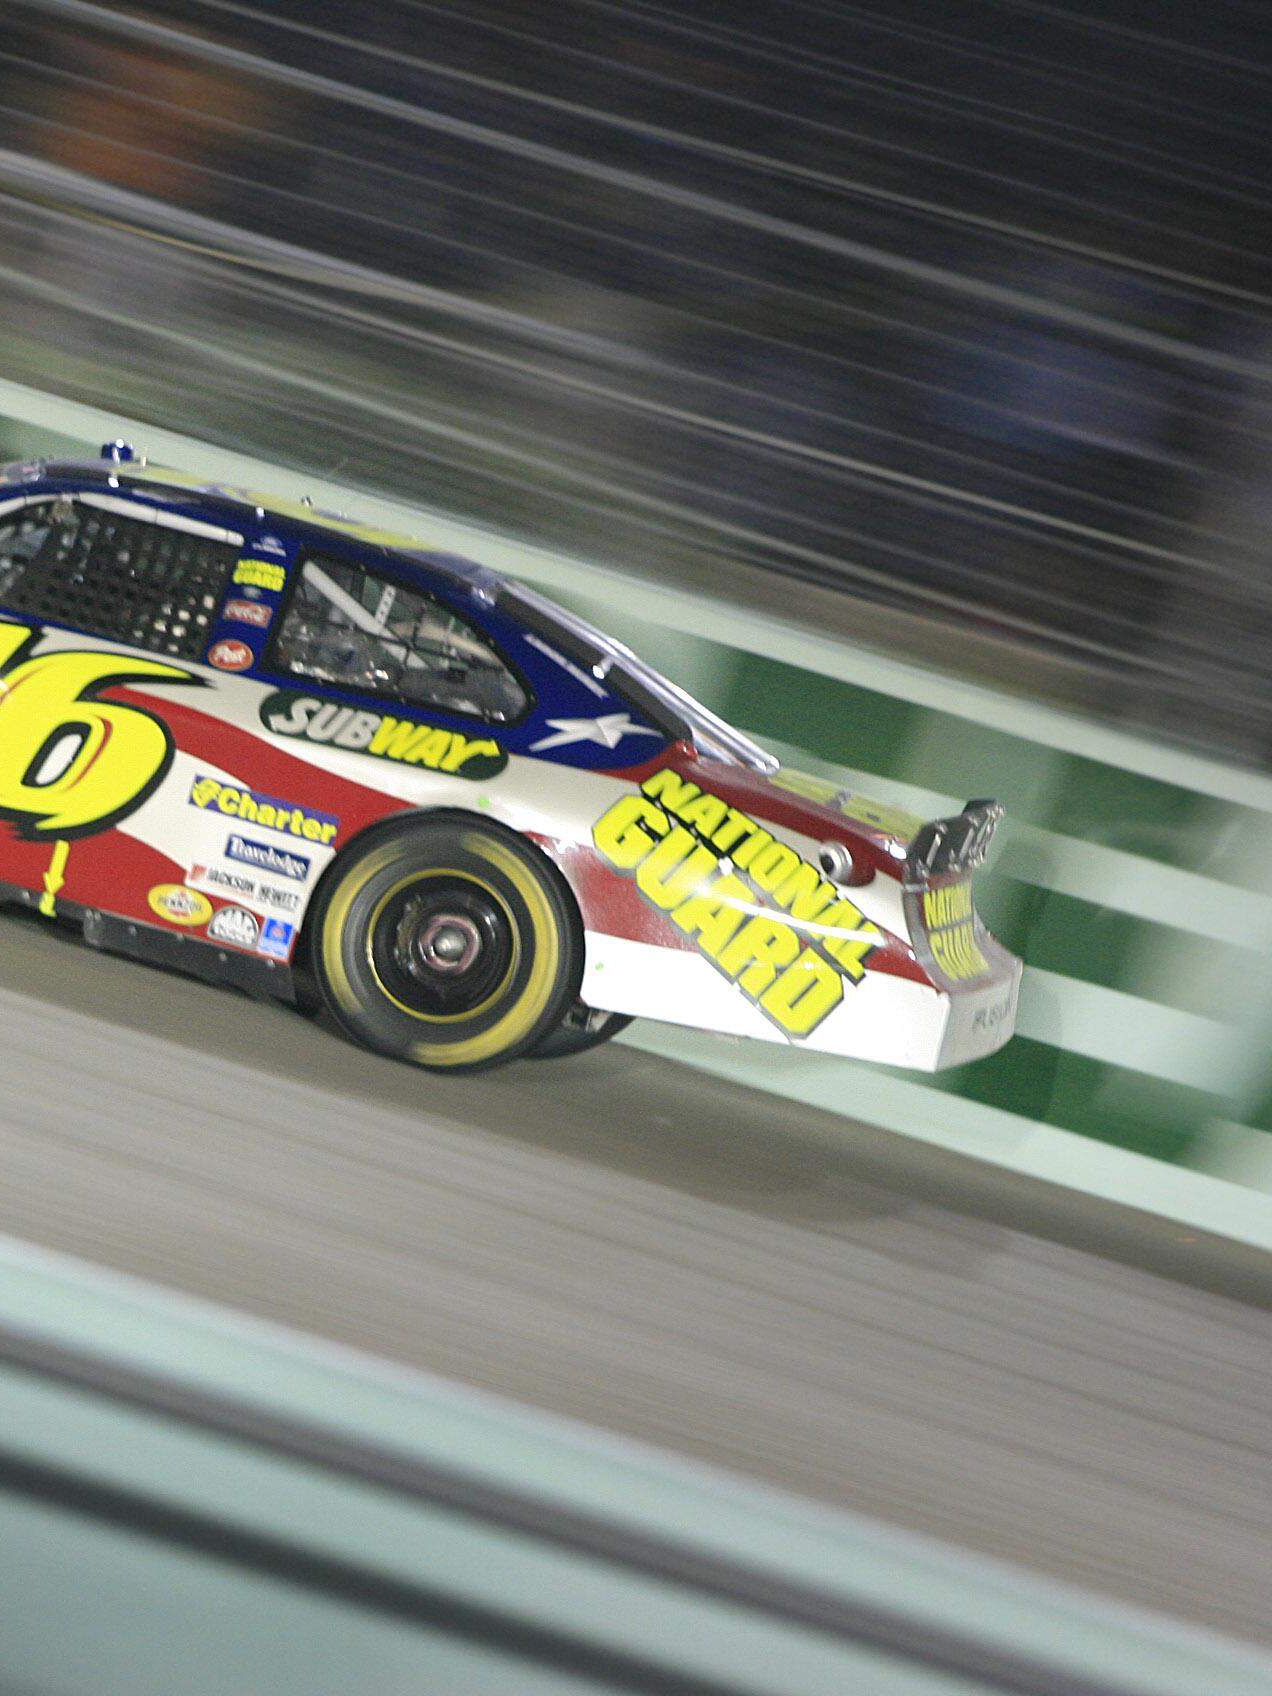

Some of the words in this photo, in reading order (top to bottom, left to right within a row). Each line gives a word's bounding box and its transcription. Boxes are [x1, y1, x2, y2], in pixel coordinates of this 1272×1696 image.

[269, 698, 500, 773] SUBWAY
[217, 786, 338, 845] Charter
[640, 769, 882, 980] NATIONAL
[592, 794, 844, 1036] GUARD
